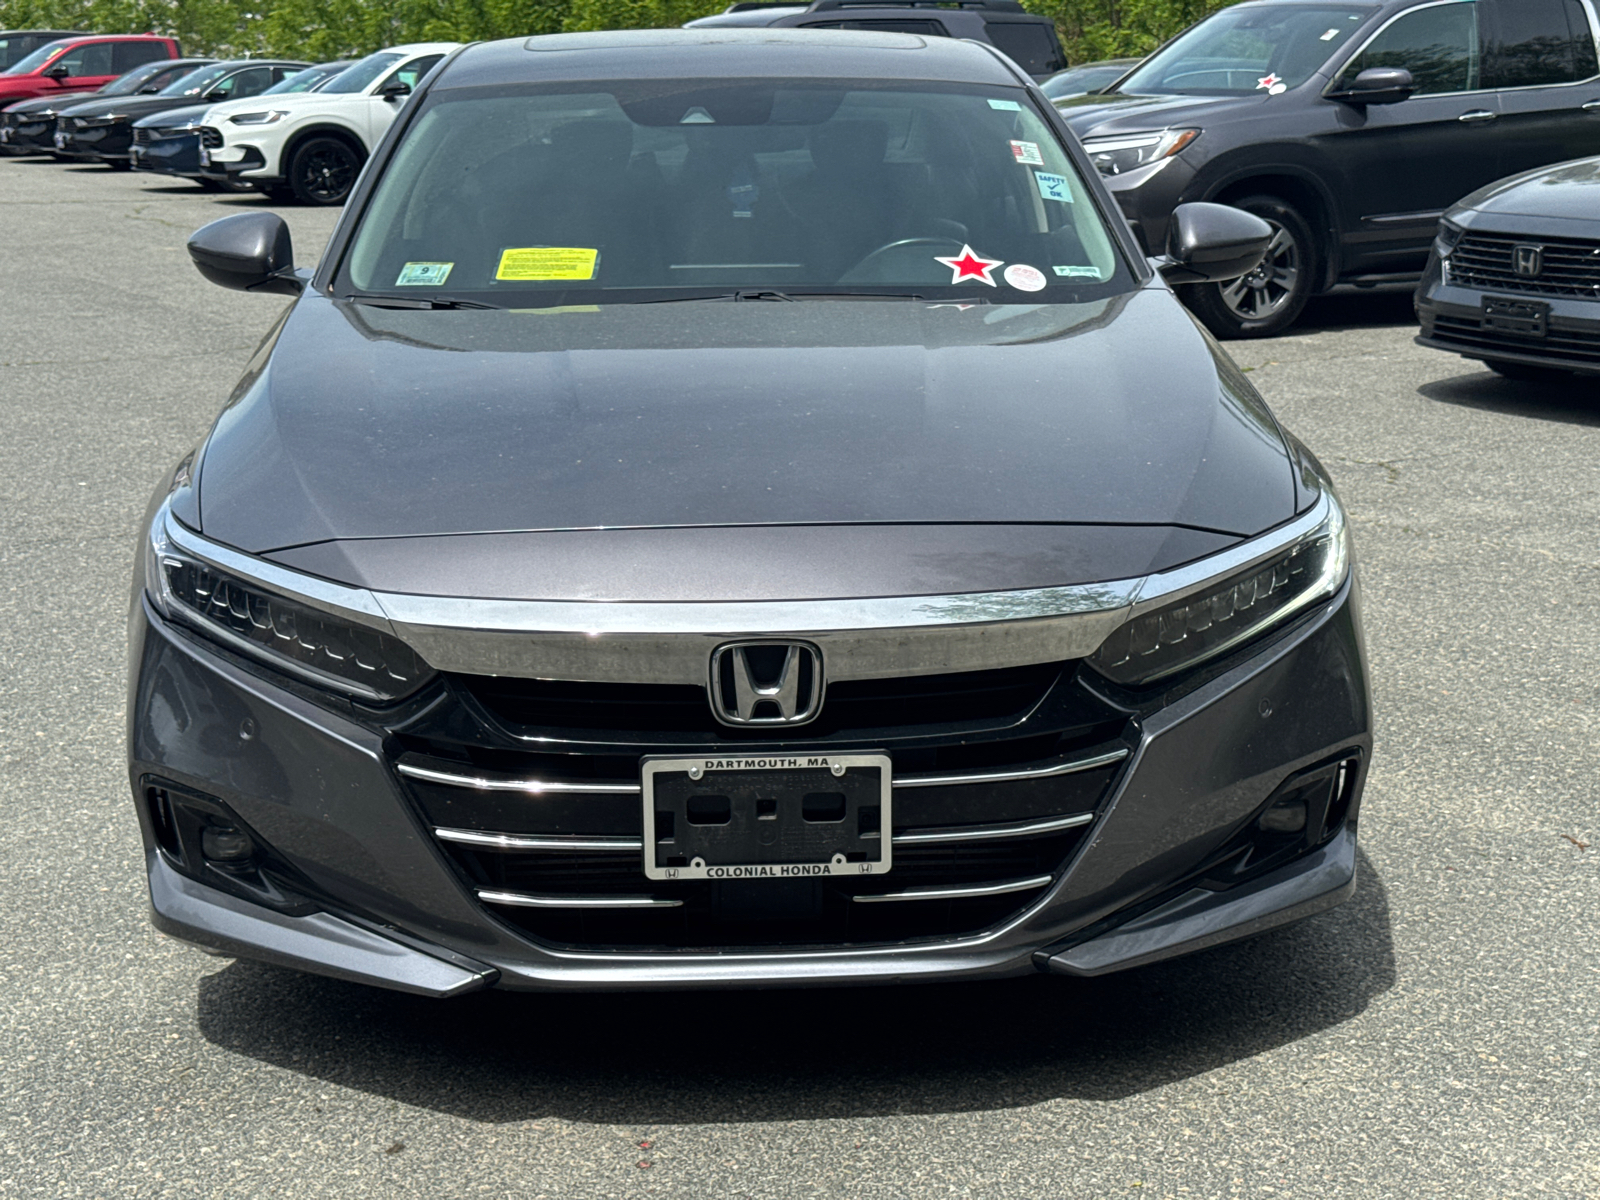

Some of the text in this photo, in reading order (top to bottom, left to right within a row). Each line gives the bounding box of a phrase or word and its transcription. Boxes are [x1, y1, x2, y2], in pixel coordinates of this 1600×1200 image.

[1038, 175, 1065, 185] SAFETY
[1050, 190, 1063, 198] OK
[420, 266, 430, 275] 9
[705, 758, 829, 769] DARTMOUTH, MA
[706, 865, 832, 878] COLONIAL HONDA
